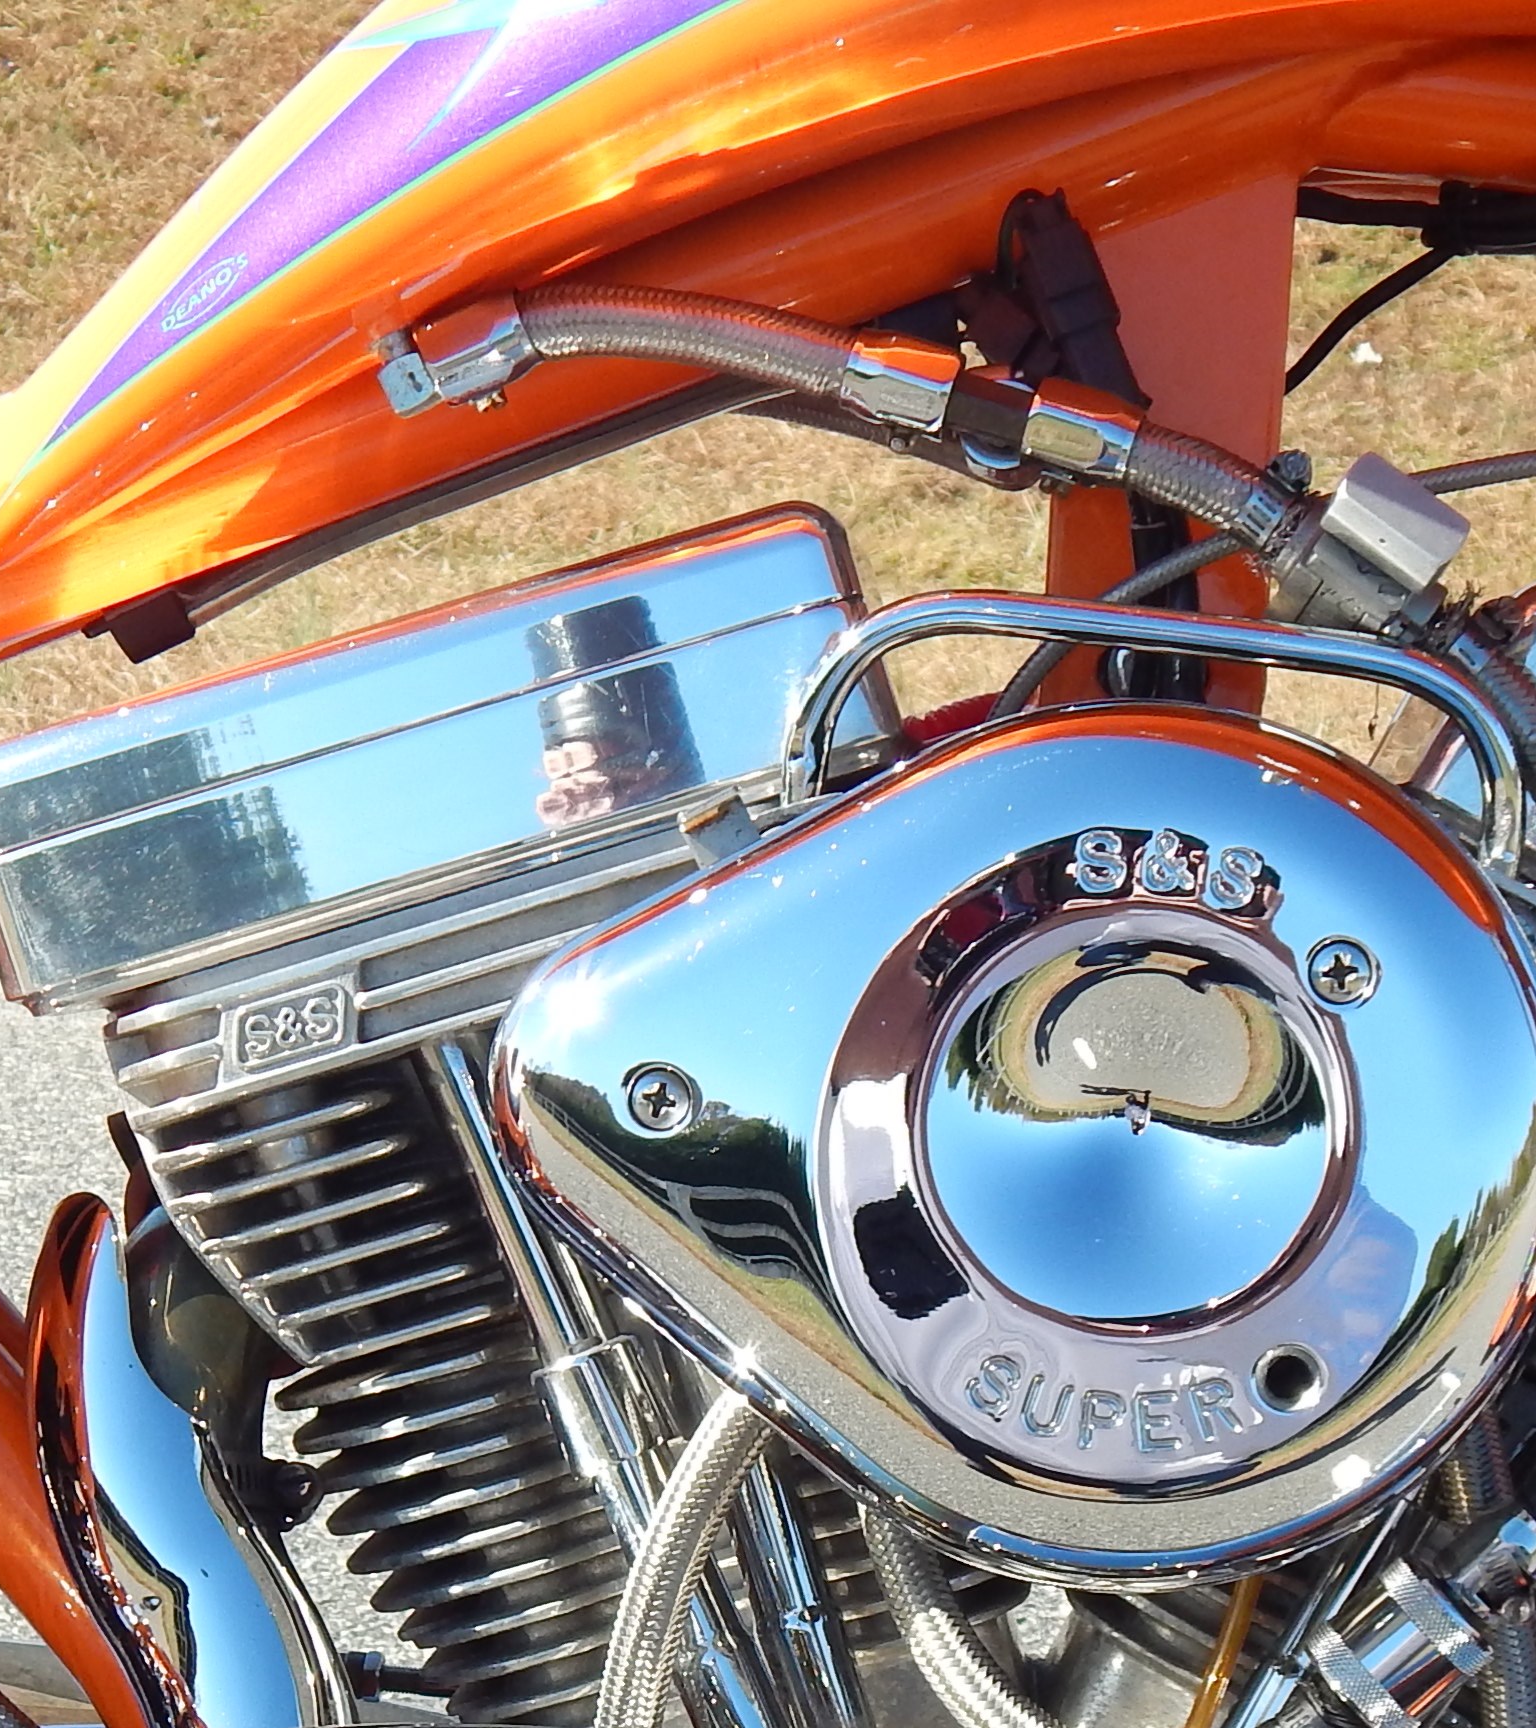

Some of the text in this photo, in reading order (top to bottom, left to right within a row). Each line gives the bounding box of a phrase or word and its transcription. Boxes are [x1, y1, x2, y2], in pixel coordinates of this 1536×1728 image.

[1075, 828, 1264, 908] S&S
[244, 996, 334, 1058] S&S
[966, 1355, 1244, 1452] SUPER
